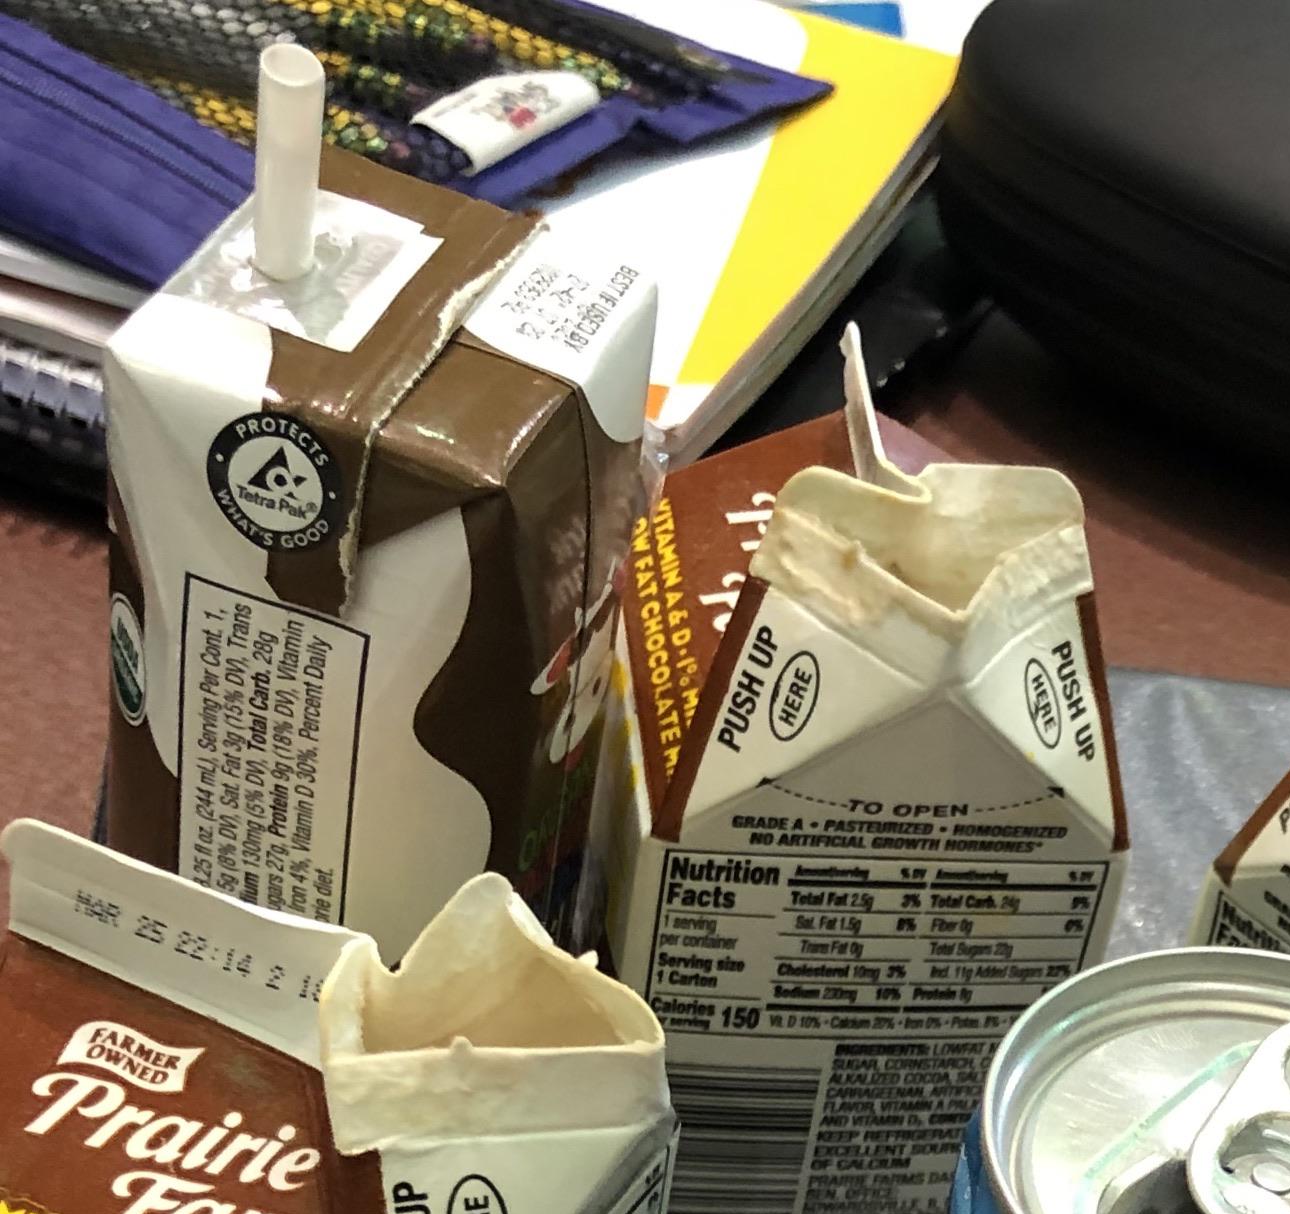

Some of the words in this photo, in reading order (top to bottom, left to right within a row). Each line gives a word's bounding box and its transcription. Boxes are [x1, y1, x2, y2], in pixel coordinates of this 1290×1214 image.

[611, 265, 639, 297] BEST
[577, 303, 611, 335] USED
[564, 331, 588, 353] BY
[235, 417, 329, 466] PROTECTS
[236, 485, 275, 509] Tetra
[218, 489, 273, 546] WHAT'S
[281, 519, 328, 548] GOOD
[653, 497, 683, 587] VITAMIN
[634, 556, 656, 599] FAT
[664, 592, 683, 608] A
[227, 603, 252, 648] Trans
[669, 610, 688, 628] &
[252, 630, 279, 665] 28g
[277, 620, 305, 681] Vitamin
[672, 629, 691, 647] D
[304, 635, 333, 680] Daily
[641, 601, 681, 744] CHOCOLATE
[200, 669, 219, 696] Per
[249, 669, 271, 711] Carb.
[718, 670, 765, 754] PUSH
[748, 625, 778, 669] UP
[778, 667, 813, 729] HERE
[299, 681, 323, 742] Percent
[1030, 673, 1058, 735] HERE
[1051, 640, 1087, 724] PUSH
[1075, 727, 1095, 763] UP
[198, 697, 222, 752] Serving
[247, 712, 267, 752] Total
[222, 752, 241, 778] Fat
[295, 784, 314, 799] D
[848, 799, 884, 818] TO
[893, 802, 968, 818] OPEN
[268, 784, 288, 838] Protein
[292, 800, 314, 852] Vitamin
[732, 816, 789, 831] GRADE
[823, 819, 933, 836] PASTEURIZED
[953, 823, 1067, 839] HOMOGENIZED
[749, 834, 774, 845] NO
[778, 835, 866, 849] ARTIFICIAL
[872, 837, 940, 851] GROWTH
[670, 857, 780, 885] Nutrition
[667, 883, 736, 908] Facts
[672, 916, 717, 934] serving
[683, 935, 738, 950] container
[658, 953, 713, 972] Serving
[717, 957, 745, 972] size
[668, 971, 718, 988] Carton
[651, 997, 715, 1017] Calories
[721, 1006, 761, 1029] 150
[86, 1044, 169, 1086] OWNED
[88, 1027, 181, 1071] FARMER
[24, 1072, 321, 1191] Prairie
